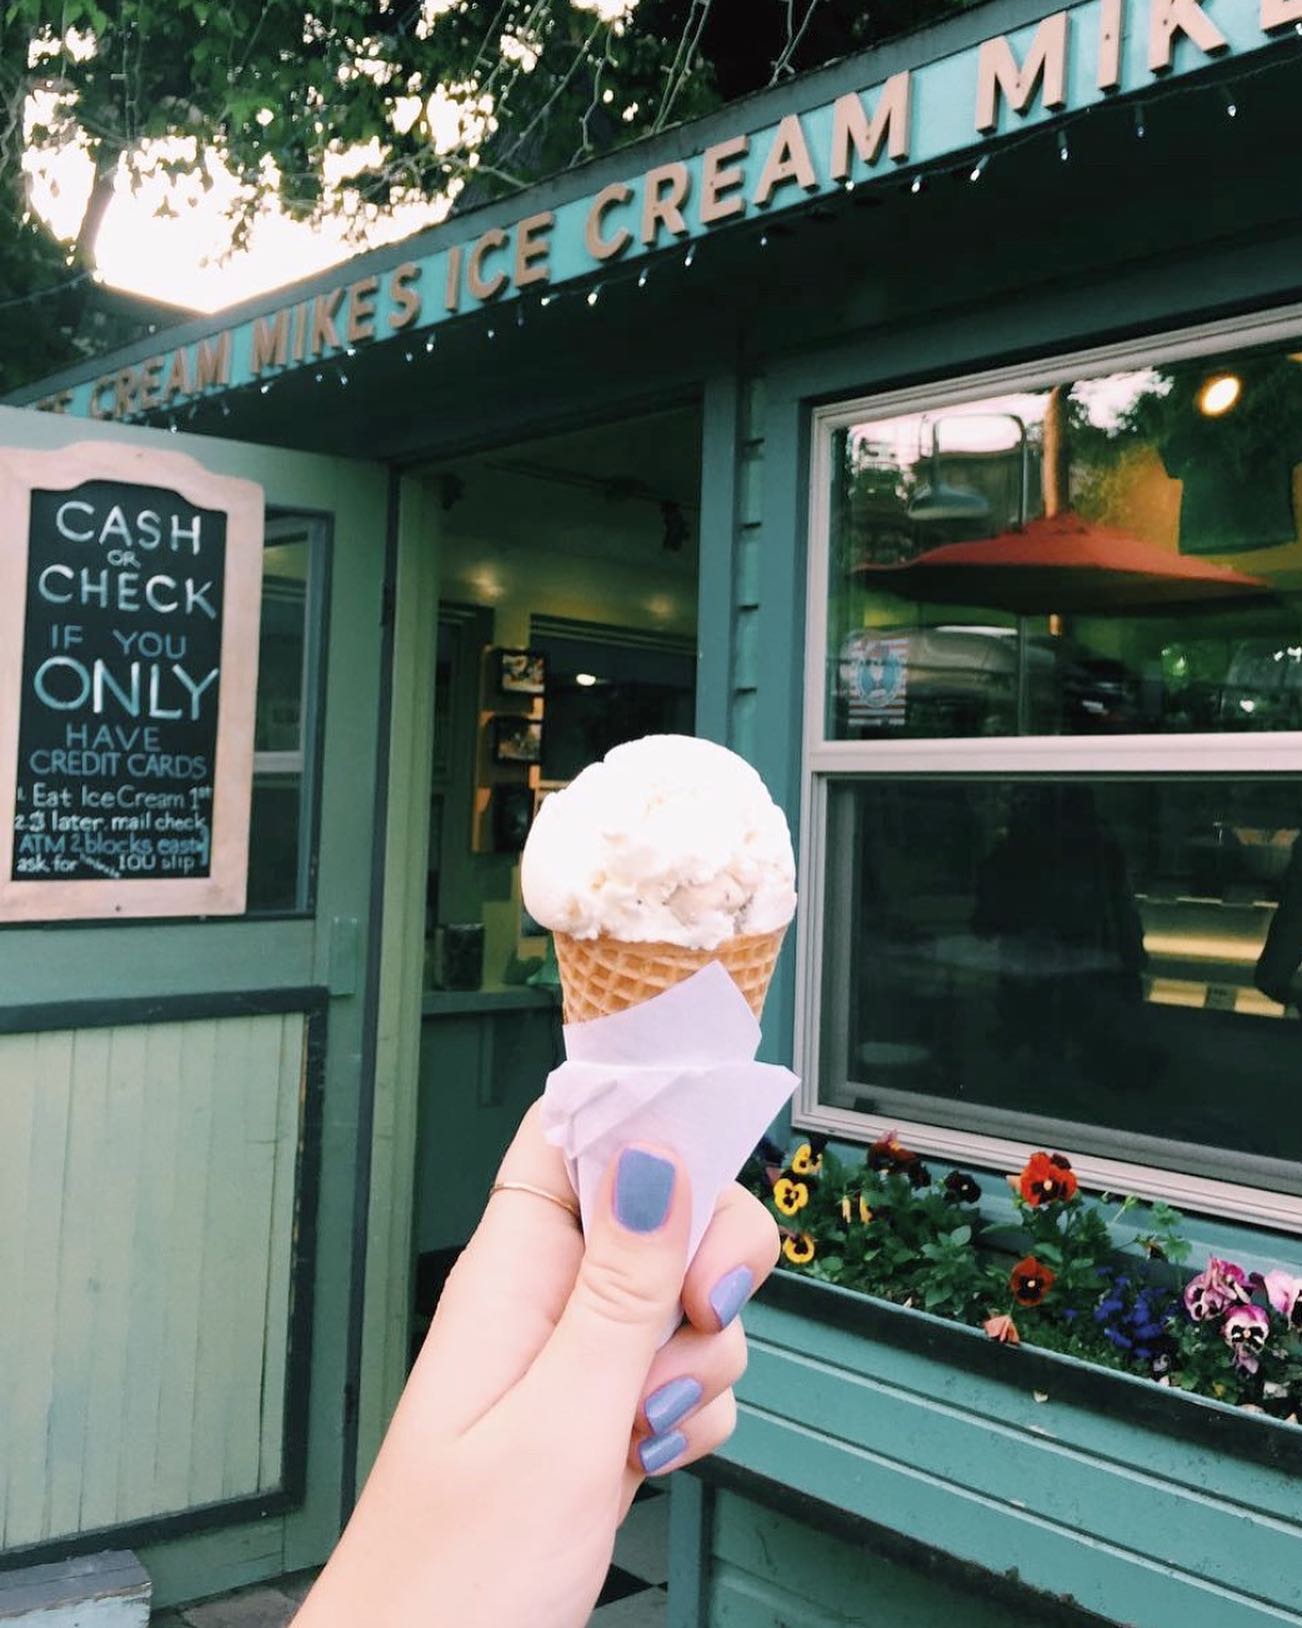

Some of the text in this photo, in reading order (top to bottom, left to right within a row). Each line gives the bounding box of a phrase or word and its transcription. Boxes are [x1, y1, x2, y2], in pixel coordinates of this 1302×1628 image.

[90, 330, 231, 418] CREAM
[252, 262, 423, 377] MIKES
[446, 210, 556, 313] ICE
[585, 69, 913, 261] CREAM
[56, 501, 201, 555] CASH
[107, 549, 141, 568] OR
[38, 564, 216, 619] CHECK
[51, 624, 187, 659] IF YOU
[33, 656, 219, 721] ONLY
[66, 722, 161, 752] HAVE
[29, 750, 208, 779] CREDIT CARDS
[33, 782, 72, 808] Eat
[111, 811, 151, 832] mail
[154, 811, 206, 832] check
[19, 833, 66, 854] ATM
[84, 831, 153, 856] blocks
[16, 853, 51, 873] ask
[54, 853, 78, 873] for
